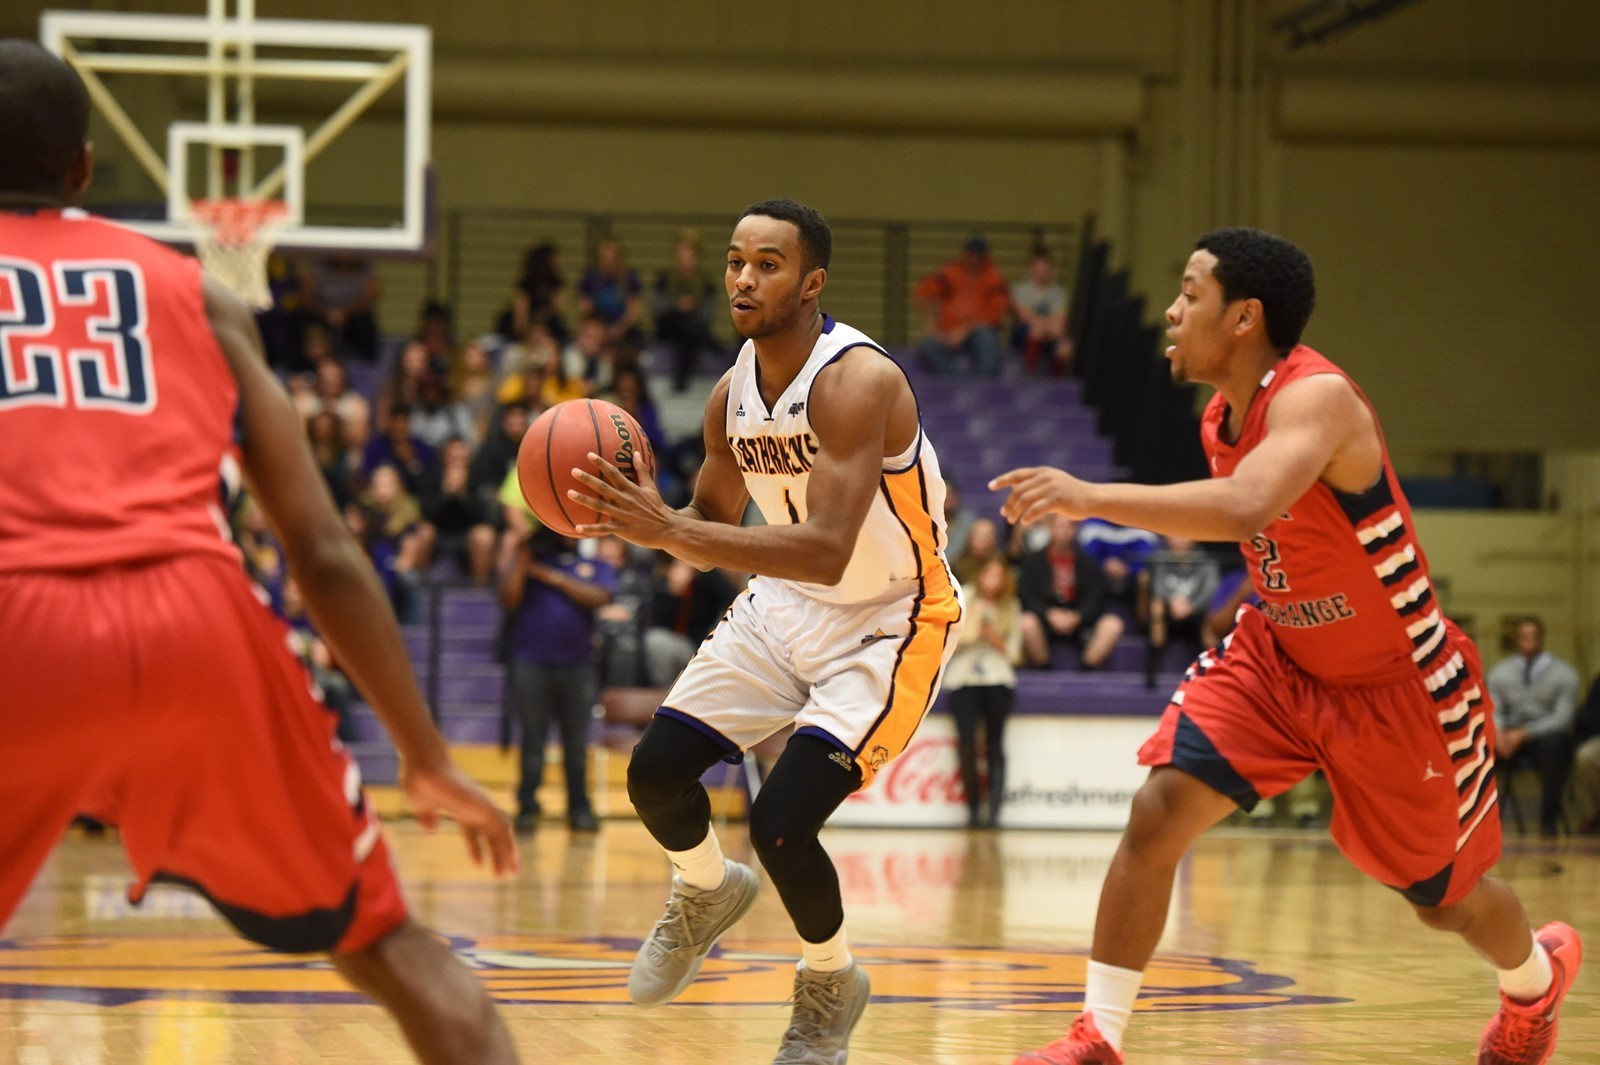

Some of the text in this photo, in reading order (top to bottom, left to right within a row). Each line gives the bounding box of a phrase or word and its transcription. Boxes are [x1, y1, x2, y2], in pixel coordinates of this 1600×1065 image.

[0, 255, 158, 416] 23
[609, 412, 638, 482] ilson
[1250, 533, 1292, 592] 2
[828, 753, 853, 772] adidas
